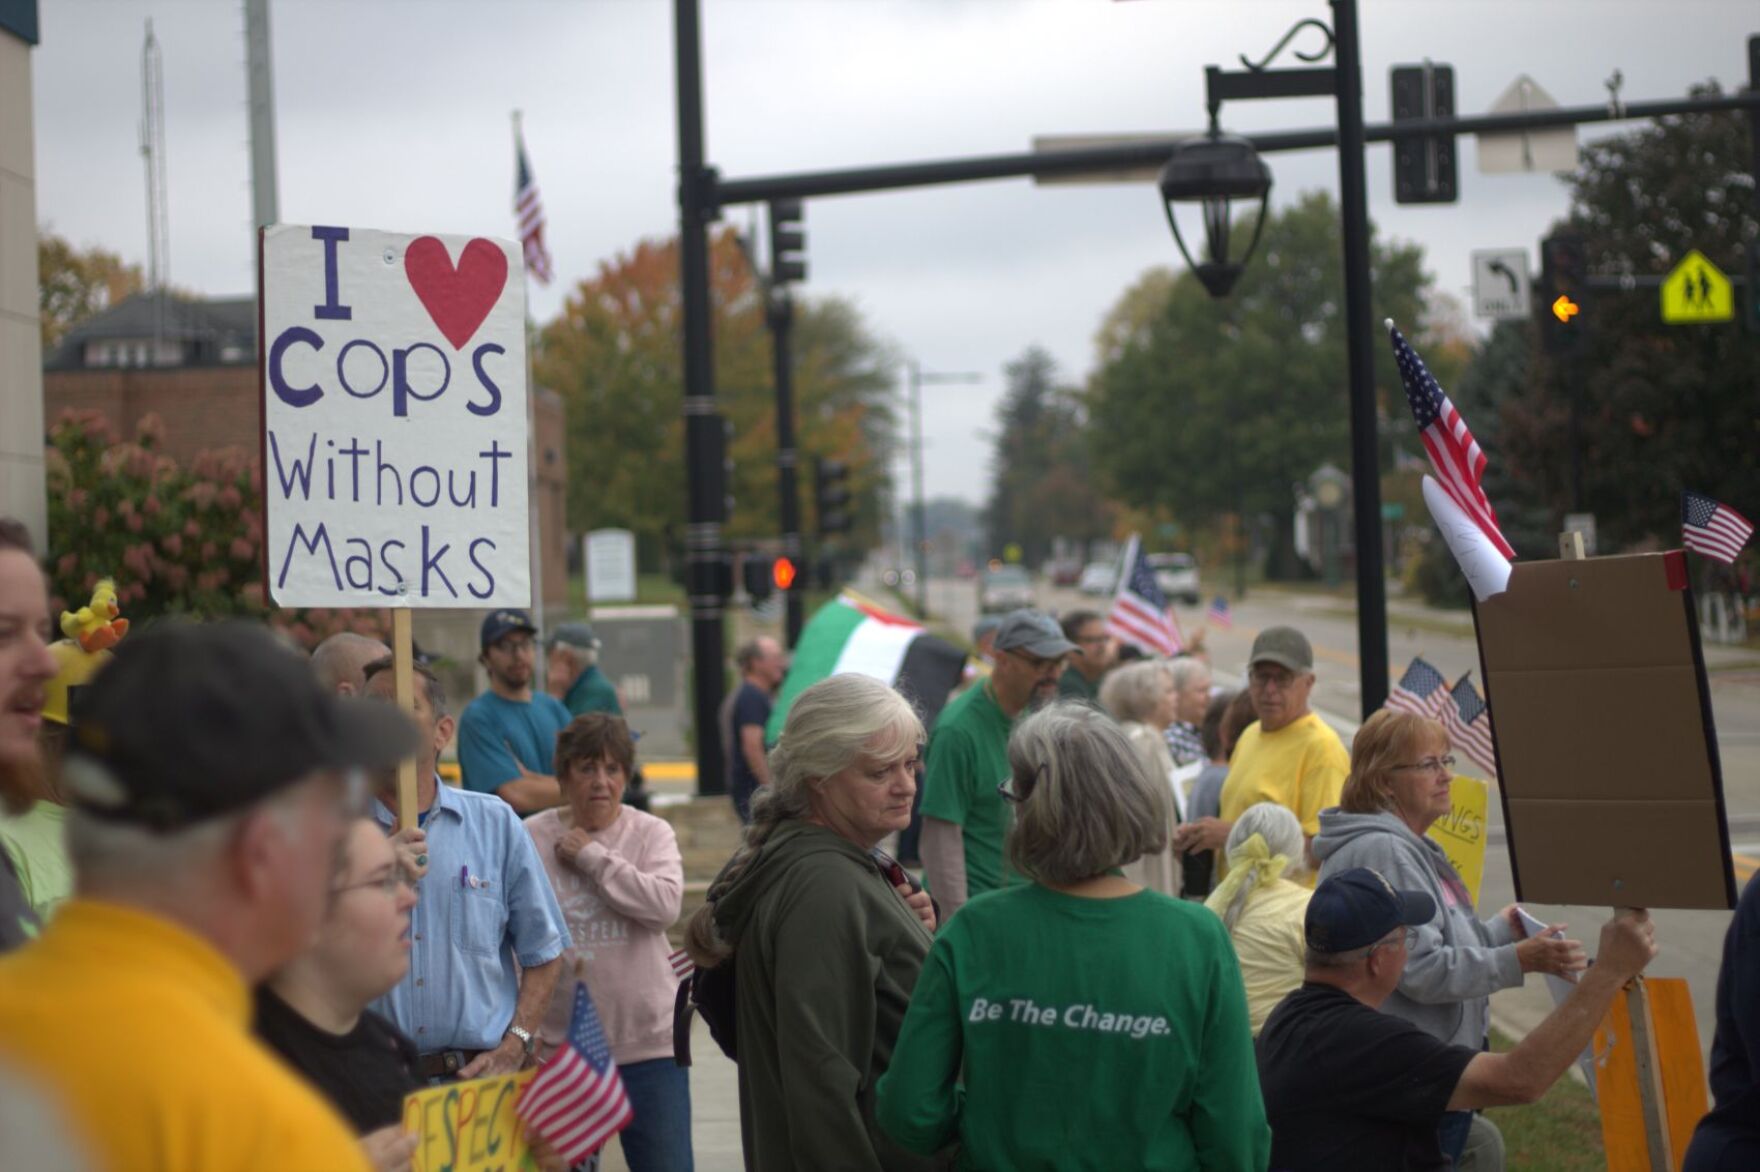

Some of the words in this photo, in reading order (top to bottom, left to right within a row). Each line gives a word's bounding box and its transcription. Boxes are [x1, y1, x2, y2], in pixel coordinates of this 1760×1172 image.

[311, 225, 352, 320] I
[268, 326, 506, 417] Cops
[267, 430, 512, 508] Without
[277, 522, 498, 599] Masks
[969, 998, 1003, 1022] Be
[1009, 999, 1058, 1026] The
[1063, 1004, 1172, 1039] Change.
